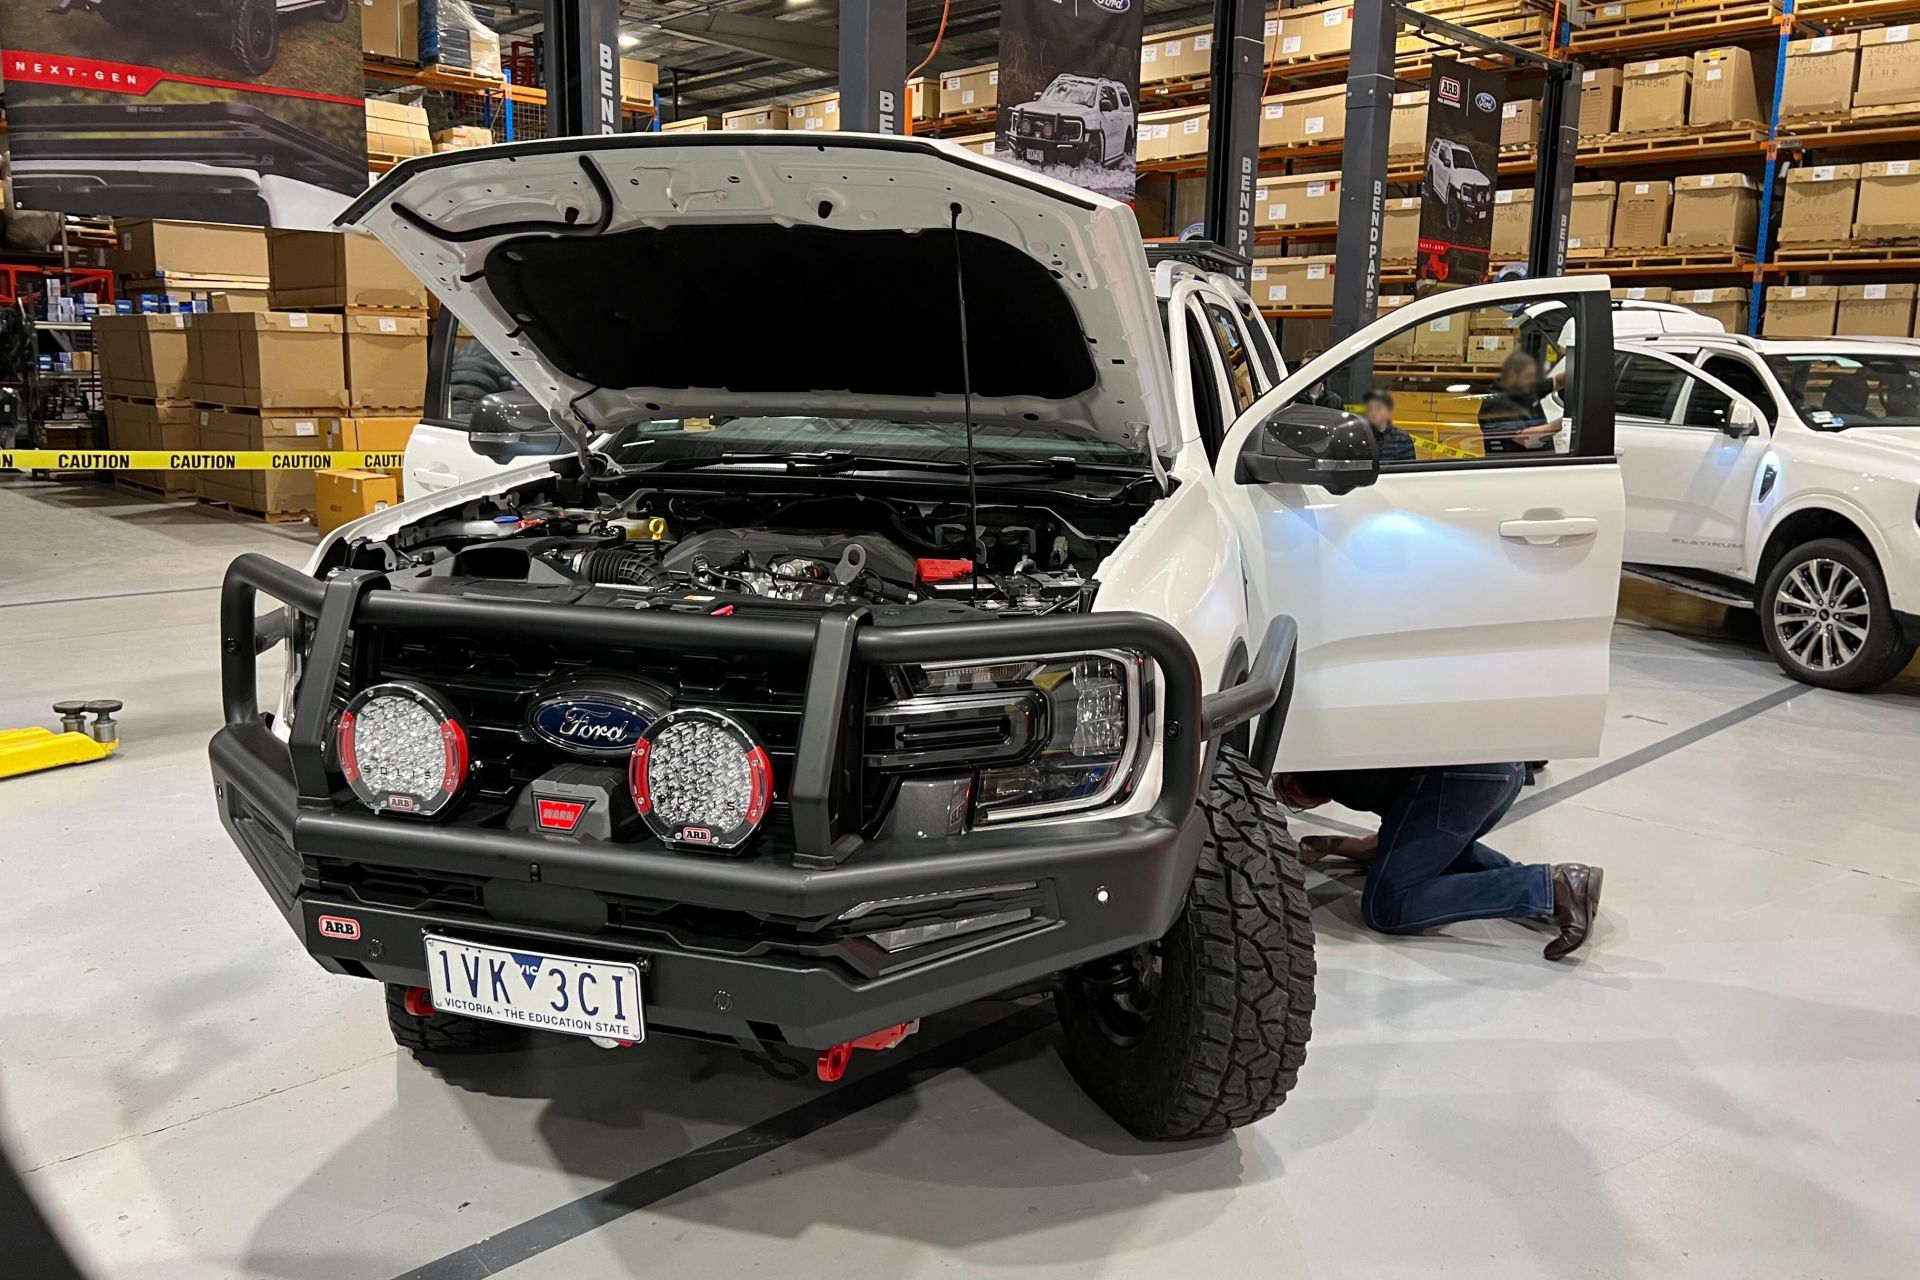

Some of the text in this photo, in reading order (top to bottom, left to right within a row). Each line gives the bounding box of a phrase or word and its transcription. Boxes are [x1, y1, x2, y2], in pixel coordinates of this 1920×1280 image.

[16, 61, 136, 85] NEXT-GEN
[1442, 81, 1458, 96] ARB
[1366, 180, 1382, 290] BENDPAK
[58, 454, 130, 468] CAUTION
[170, 454, 236, 469] CAUTION
[272, 454, 331, 468] CAUTION
[559, 707, 629, 742] Ford
[391, 798, 410, 808] ARB
[543, 808, 575, 820] WARN
[686, 829, 707, 840] ARB
[325, 920, 355, 935] ARB
[517, 963, 539, 976] VIC
[439, 950, 626, 1021] 1VK 3CI
[445, 997, 493, 1015] VICTORIA
[505, 1008, 525, 1020] THE
[528, 1012, 592, 1030] EDUCATION
[595, 1021, 630, 1035] STATE
